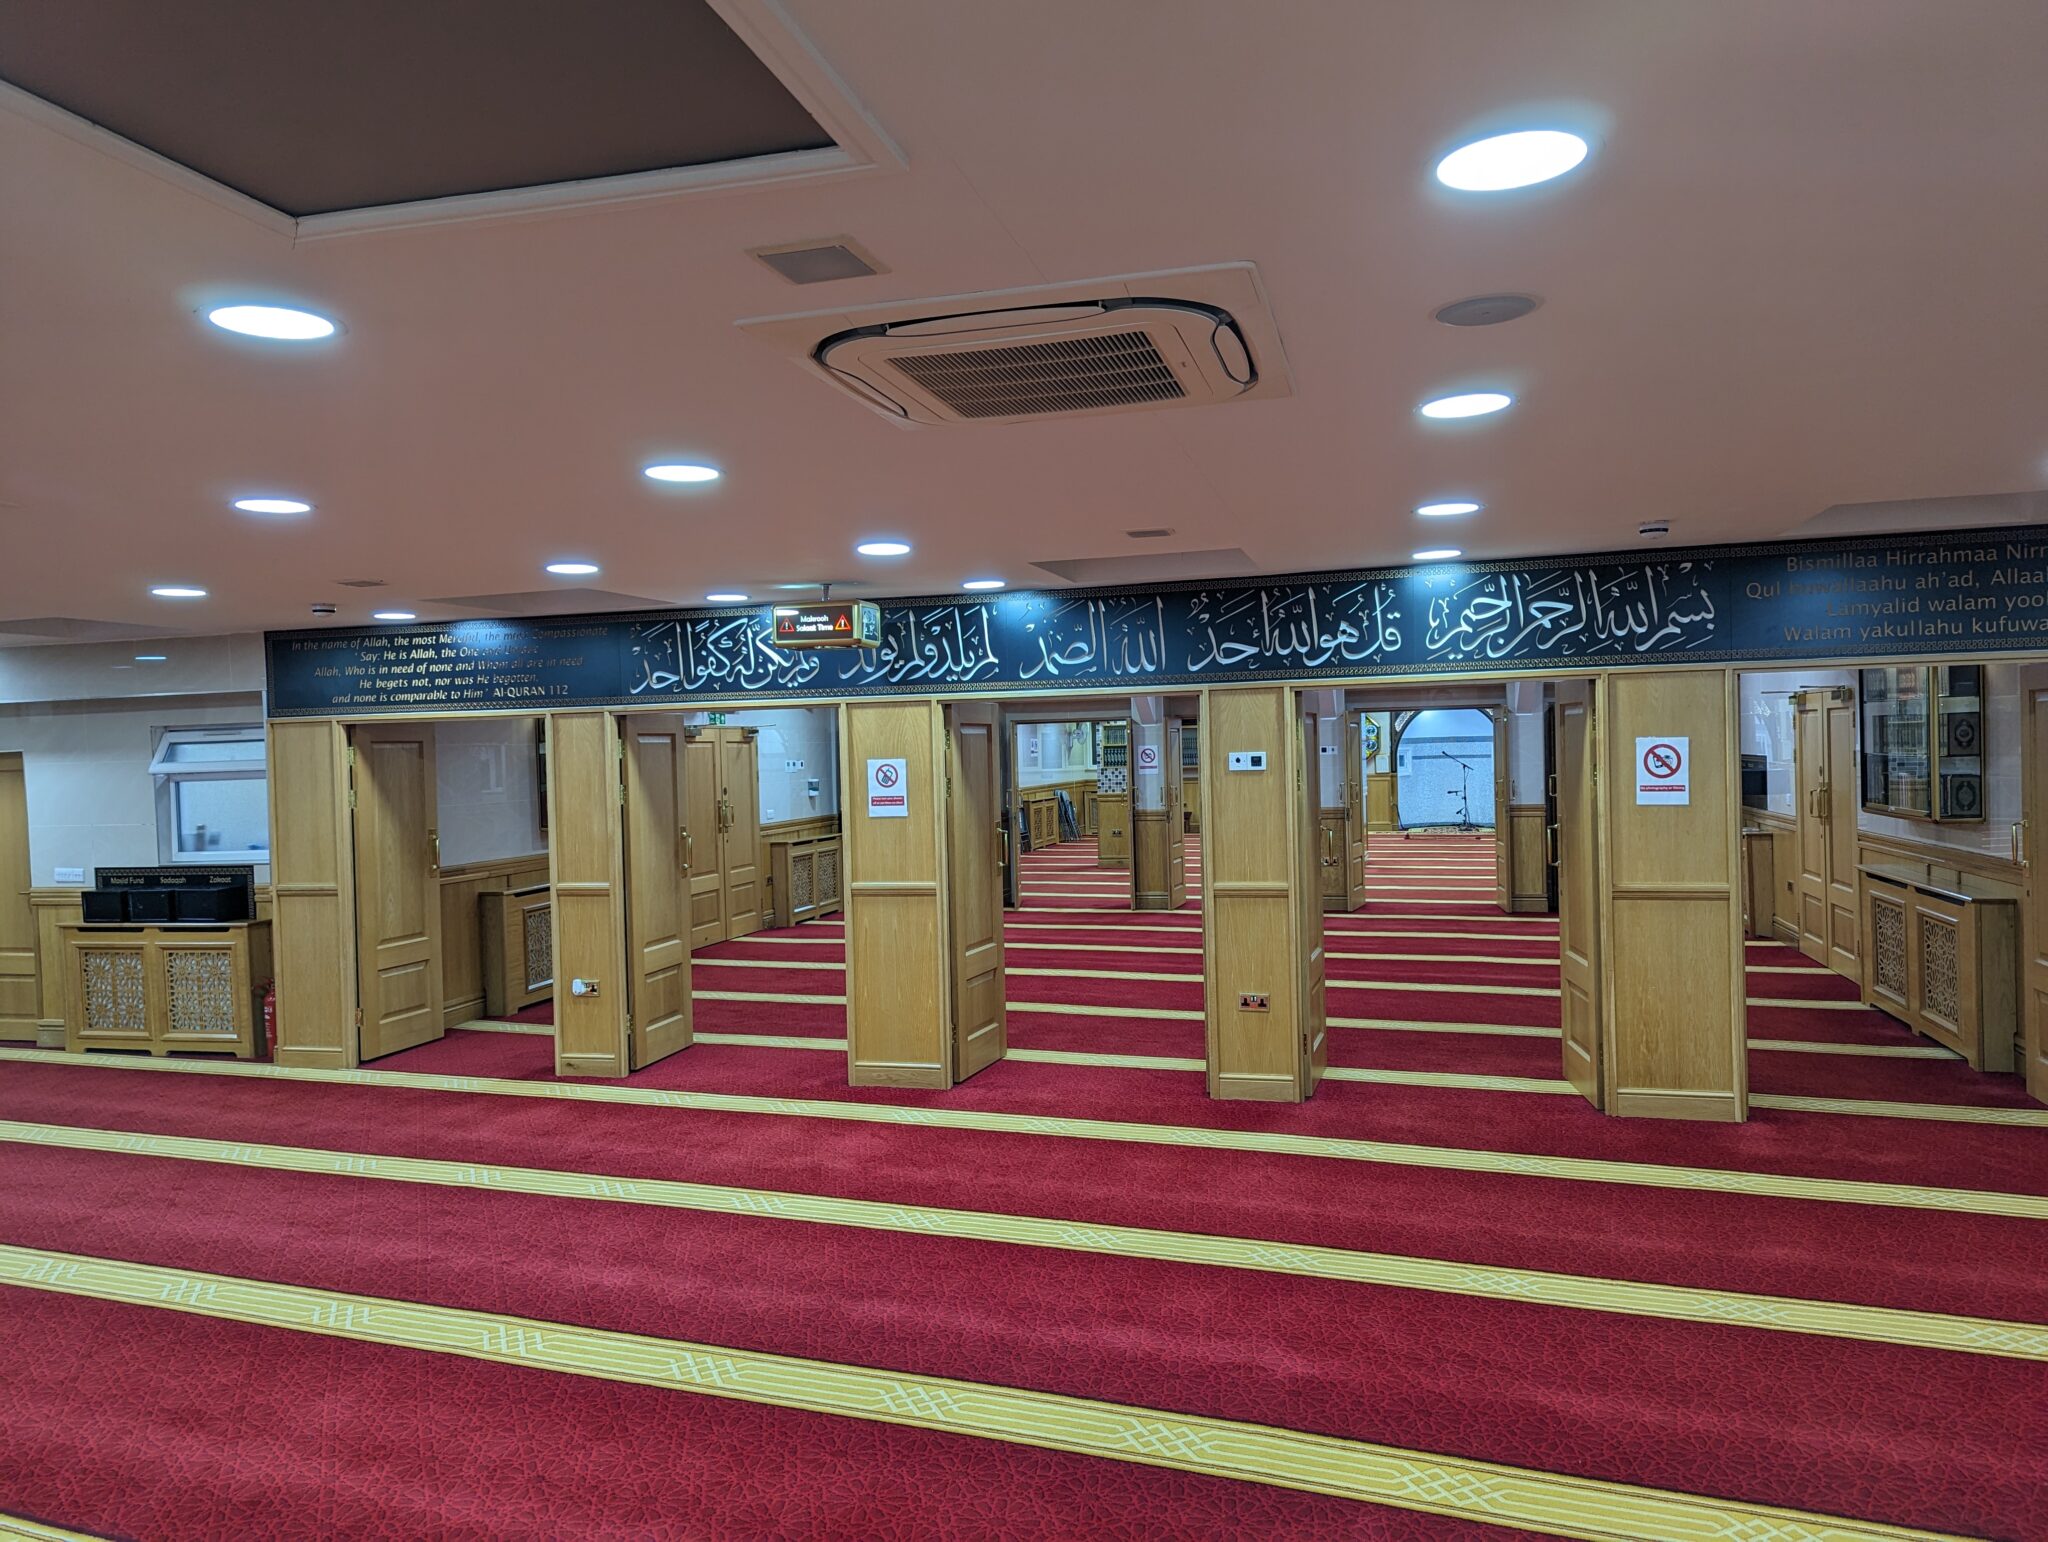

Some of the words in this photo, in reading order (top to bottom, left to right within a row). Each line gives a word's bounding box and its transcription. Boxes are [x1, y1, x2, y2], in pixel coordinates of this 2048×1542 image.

[1786, 552, 1878, 572] Bismillaa
[1886, 547, 1998, 566] Hirrahmaa
[1745, 582, 1780, 599] Qul
[1826, 596, 1921, 618] Lamyalid
[1928, 594, 1997, 612] walam
[818, 623, 834, 632] Time
[1784, 625, 1852, 641] Walam
[1860, 618, 1963, 641] yakullahu
[292, 641, 301, 651] In
[304, 640, 319, 650] the
[321, 640, 348, 650] name
[350, 638, 361, 650] of
[363, 636, 391, 648] Allah,
[394, 635, 410, 646] the
[412, 634, 436, 645] most
[383, 649, 397, 660] He
[399, 648, 407, 659] is
[410, 647, 437, 660] Allah,
[441, 647, 457, 658] the
[459, 646, 479, 658] One
[314, 666, 341, 678] Allah,
[345, 665, 366, 676] Who
[368, 664, 376, 675] is
[379, 663, 388, 674] in
[391, 663, 414, 674] need
[416, 662, 428, 674] of
[429, 662, 453, 672] none
[455, 660, 475, 672] and
[478, 659, 509, 671] Whom
[511, 658, 524, 669] all
[527, 658, 543, 668] are
[559, 655, 584, 667] need
[359, 679, 372, 689] He
[376, 677, 408, 690] begets
[412, 676, 432, 688] not,
[435, 677, 452, 686] nor
[454, 676, 474, 686] was
[476, 674, 490, 685] He
[332, 692, 351, 703] and
[353, 693, 377, 703] none
[379, 691, 388, 702] is
[390, 689, 448, 703] comparable
[450, 690, 461, 700] to
[493, 685, 547, 698] Al-QURAN
[549, 684, 569, 696] 112
[129, 876, 145, 884] Fund
